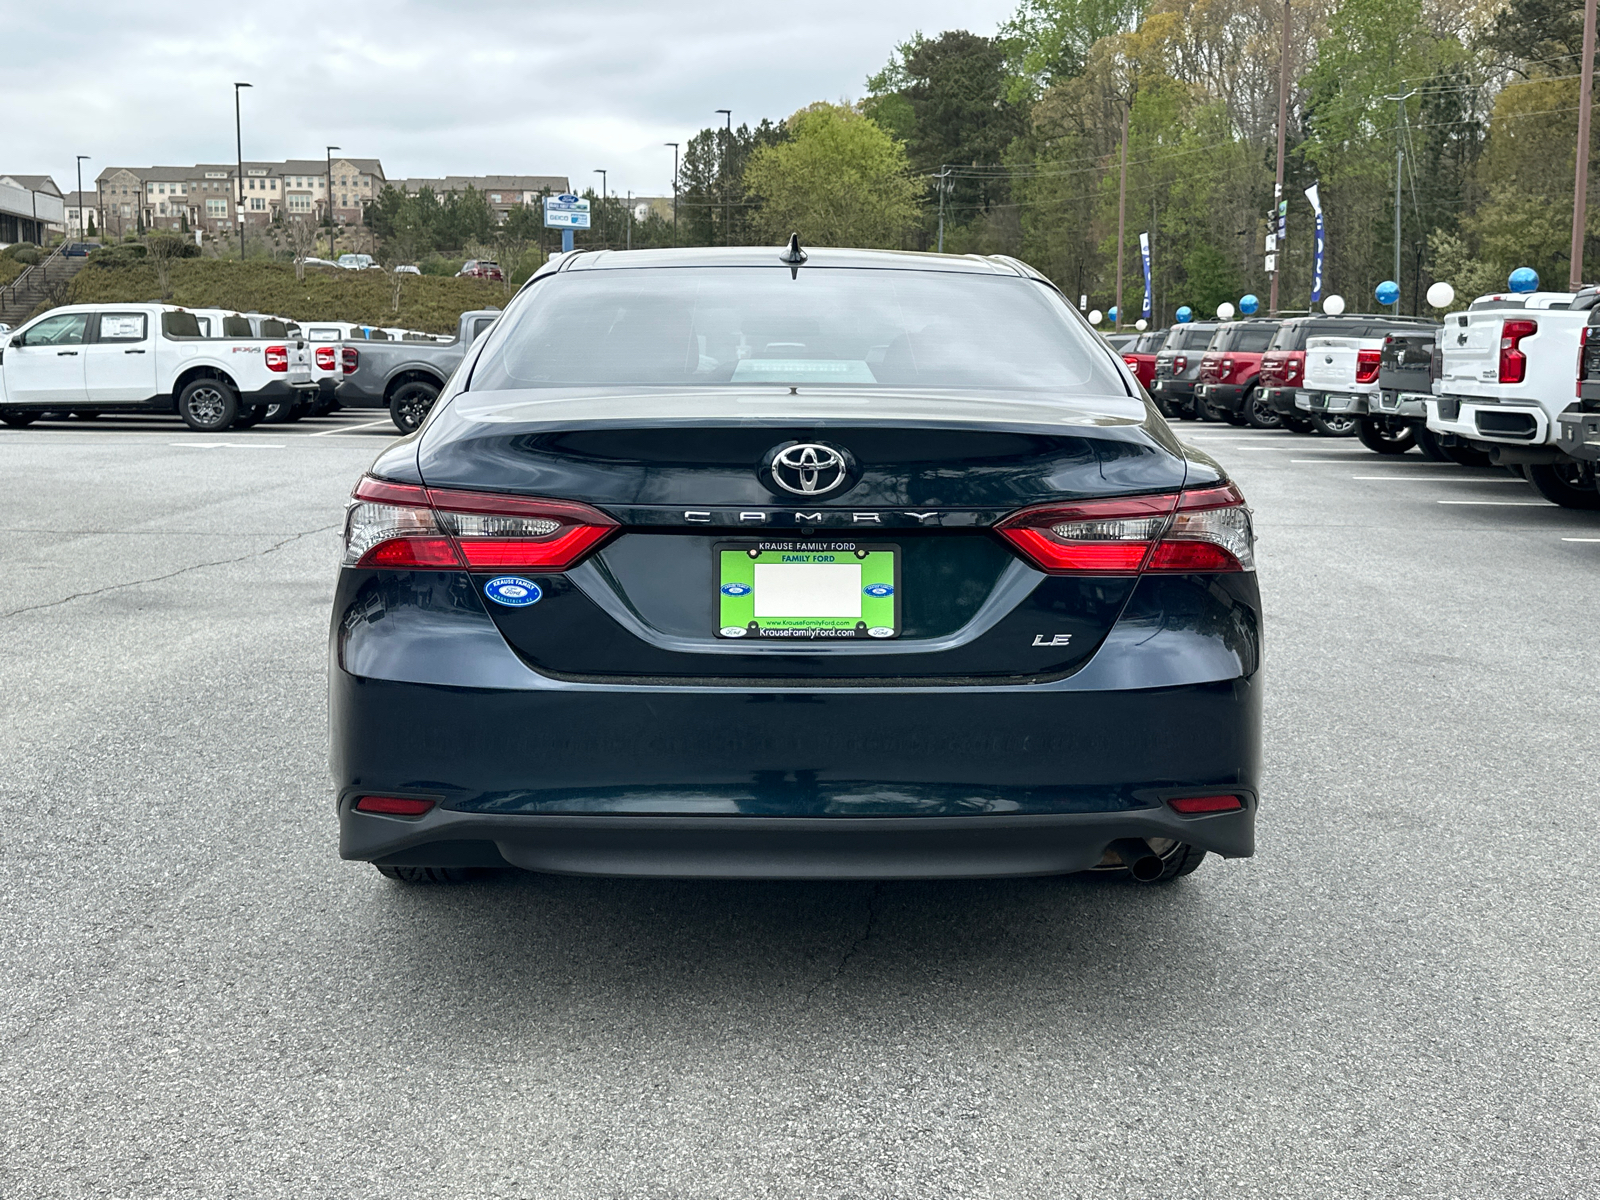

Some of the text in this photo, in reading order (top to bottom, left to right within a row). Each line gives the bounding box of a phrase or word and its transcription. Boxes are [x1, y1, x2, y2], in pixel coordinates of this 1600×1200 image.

[684, 511, 938, 523] CAMRY
[759, 542, 856, 551] KRAUSE FAMILY FORD
[781, 555, 835, 563] FAMILY FORD
[493, 579, 535, 590] KRAUSE FAMILY
[504, 586, 522, 596] Ford
[766, 619, 850, 627] www.KrauseFamilyFord.com
[725, 628, 742, 636] Ford
[759, 627, 855, 638] KrauseFamilyFord.com
[872, 628, 889, 636] Ford
[1031, 634, 1073, 647] LE
